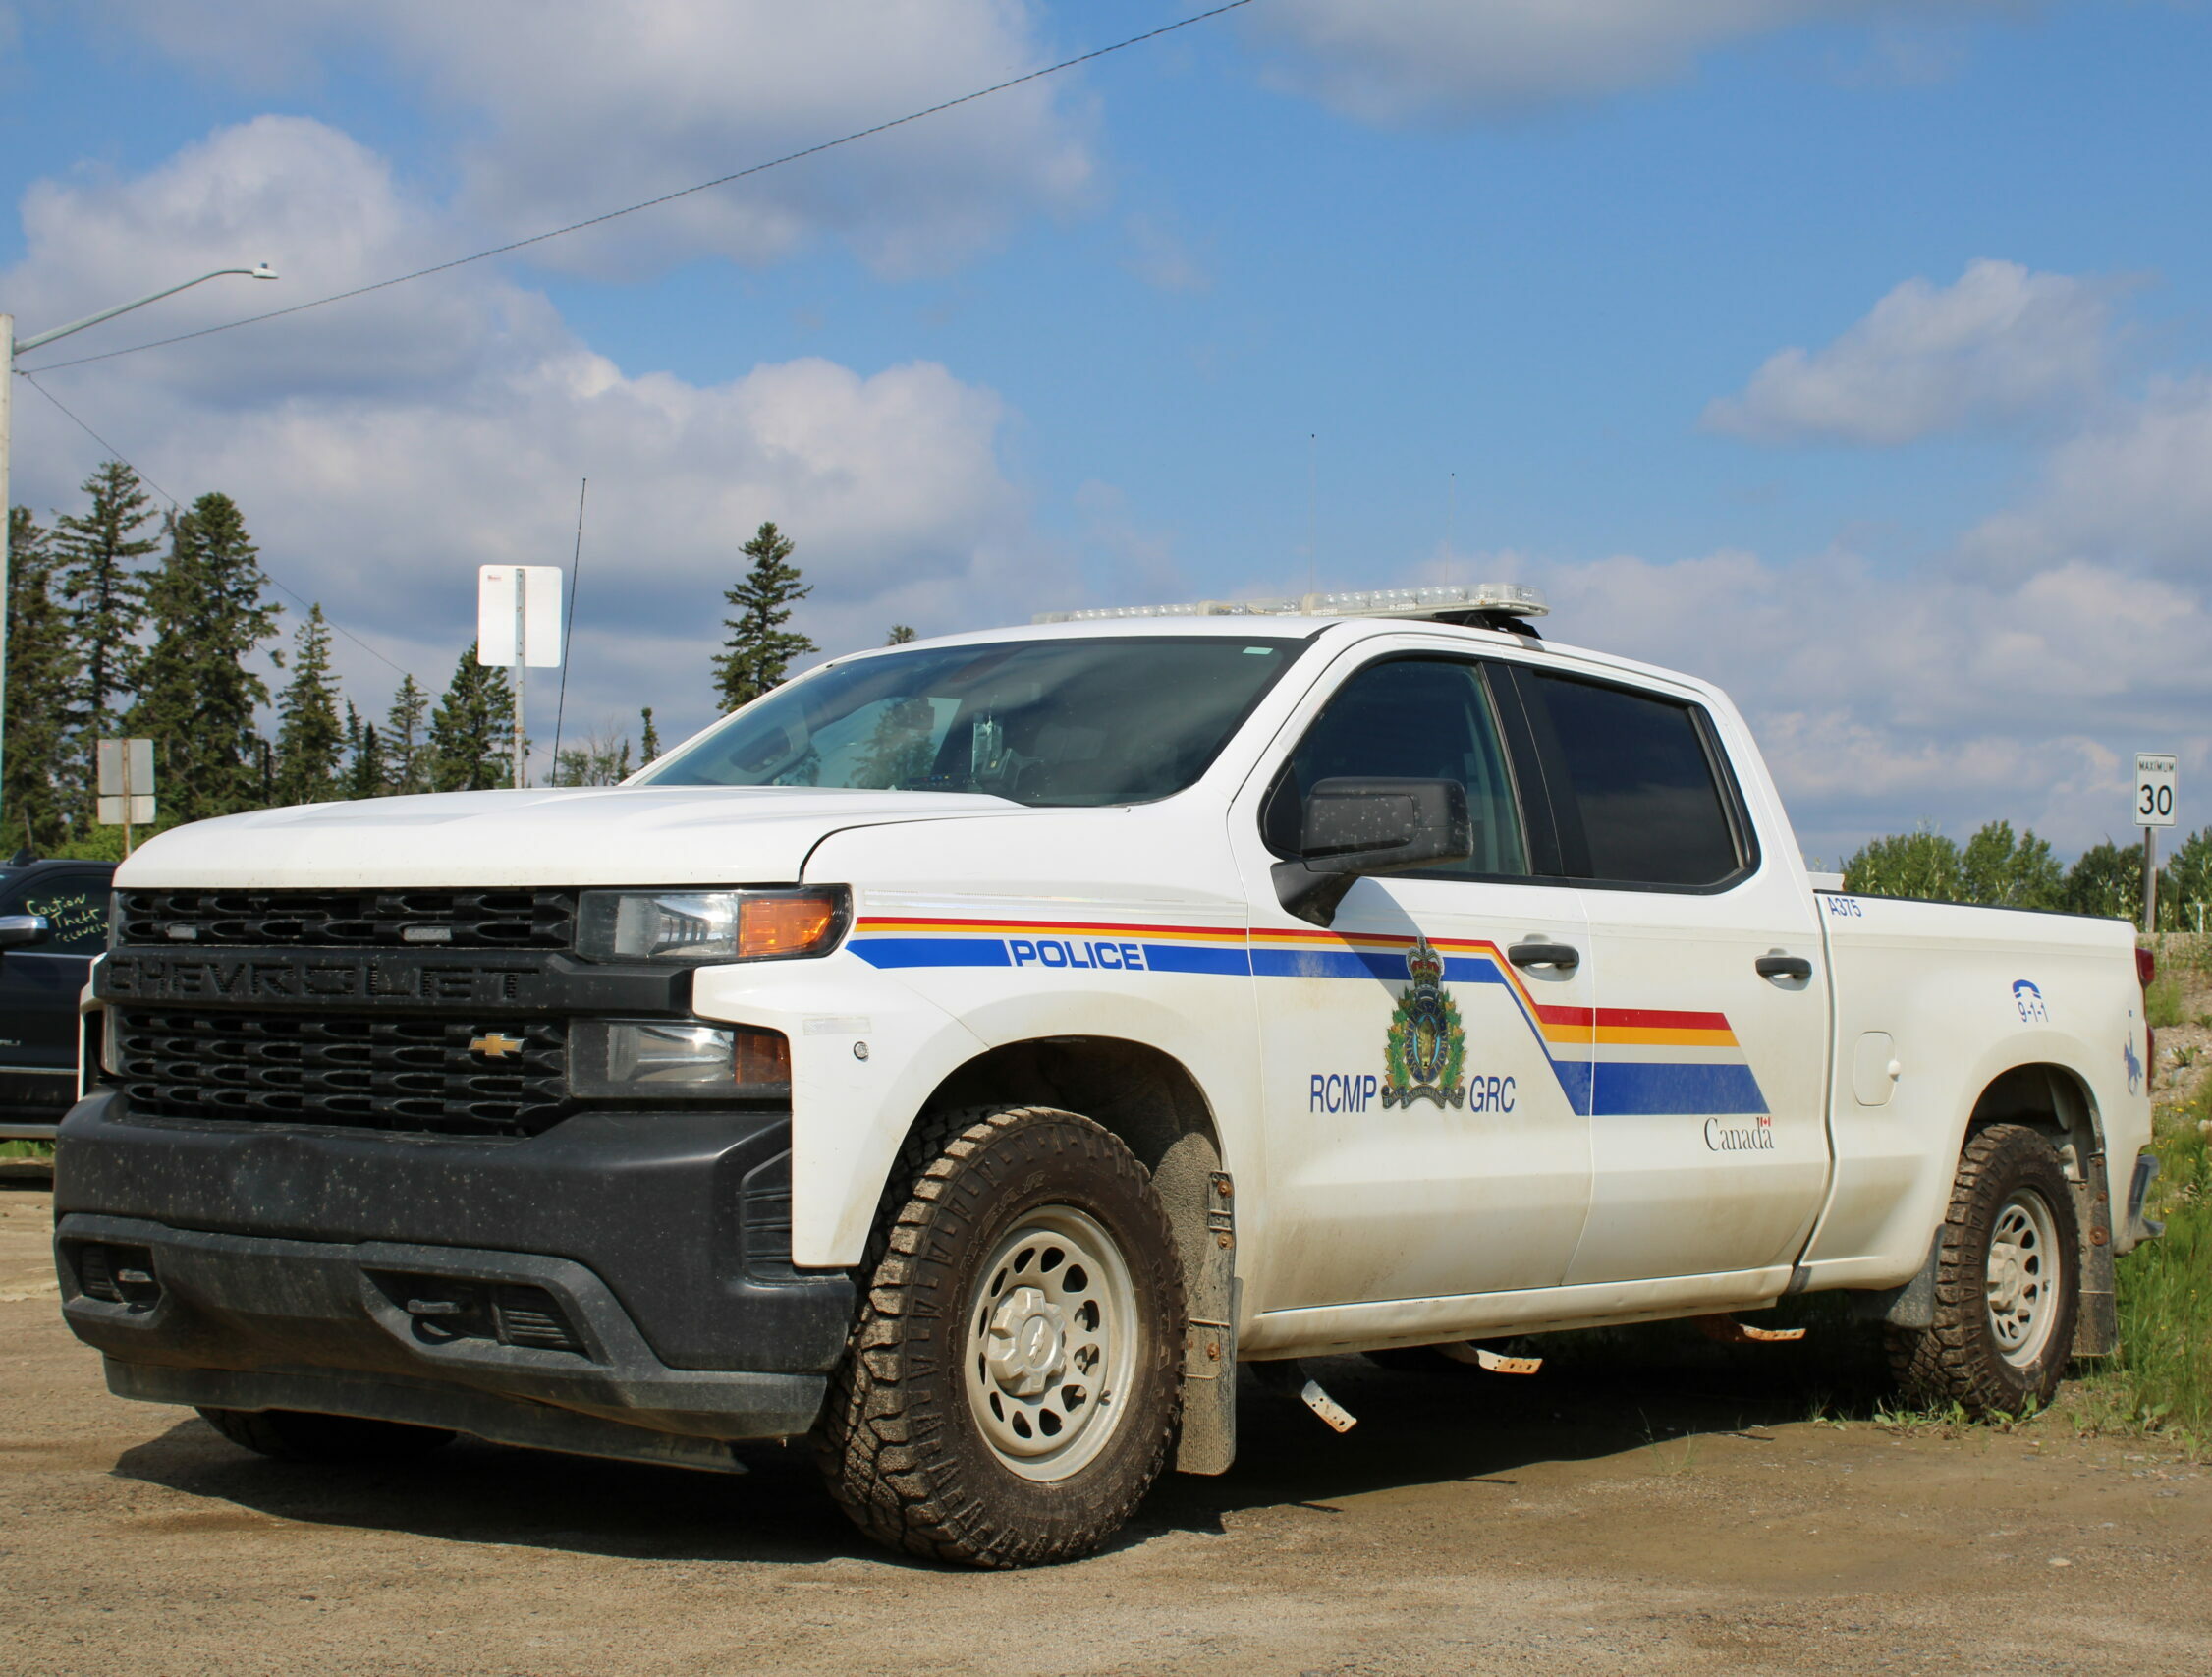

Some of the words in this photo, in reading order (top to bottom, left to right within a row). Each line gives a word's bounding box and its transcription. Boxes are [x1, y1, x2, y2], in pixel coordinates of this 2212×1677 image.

[2138, 760, 2175, 773] MAXIMUM
[2139, 783, 2173, 816] 30
[49, 908, 100, 929] Theft
[1827, 896, 1862, 918] A375
[1009, 939, 1145, 971] POLICE
[106, 959, 540, 1000] CHEVROLET
[2018, 1001, 2049, 1023] 9-1-1
[1309, 1073, 1377, 1114] RCMP
[1469, 1075, 1516, 1114] GRC
[1703, 1116, 1775, 1152] Canada
